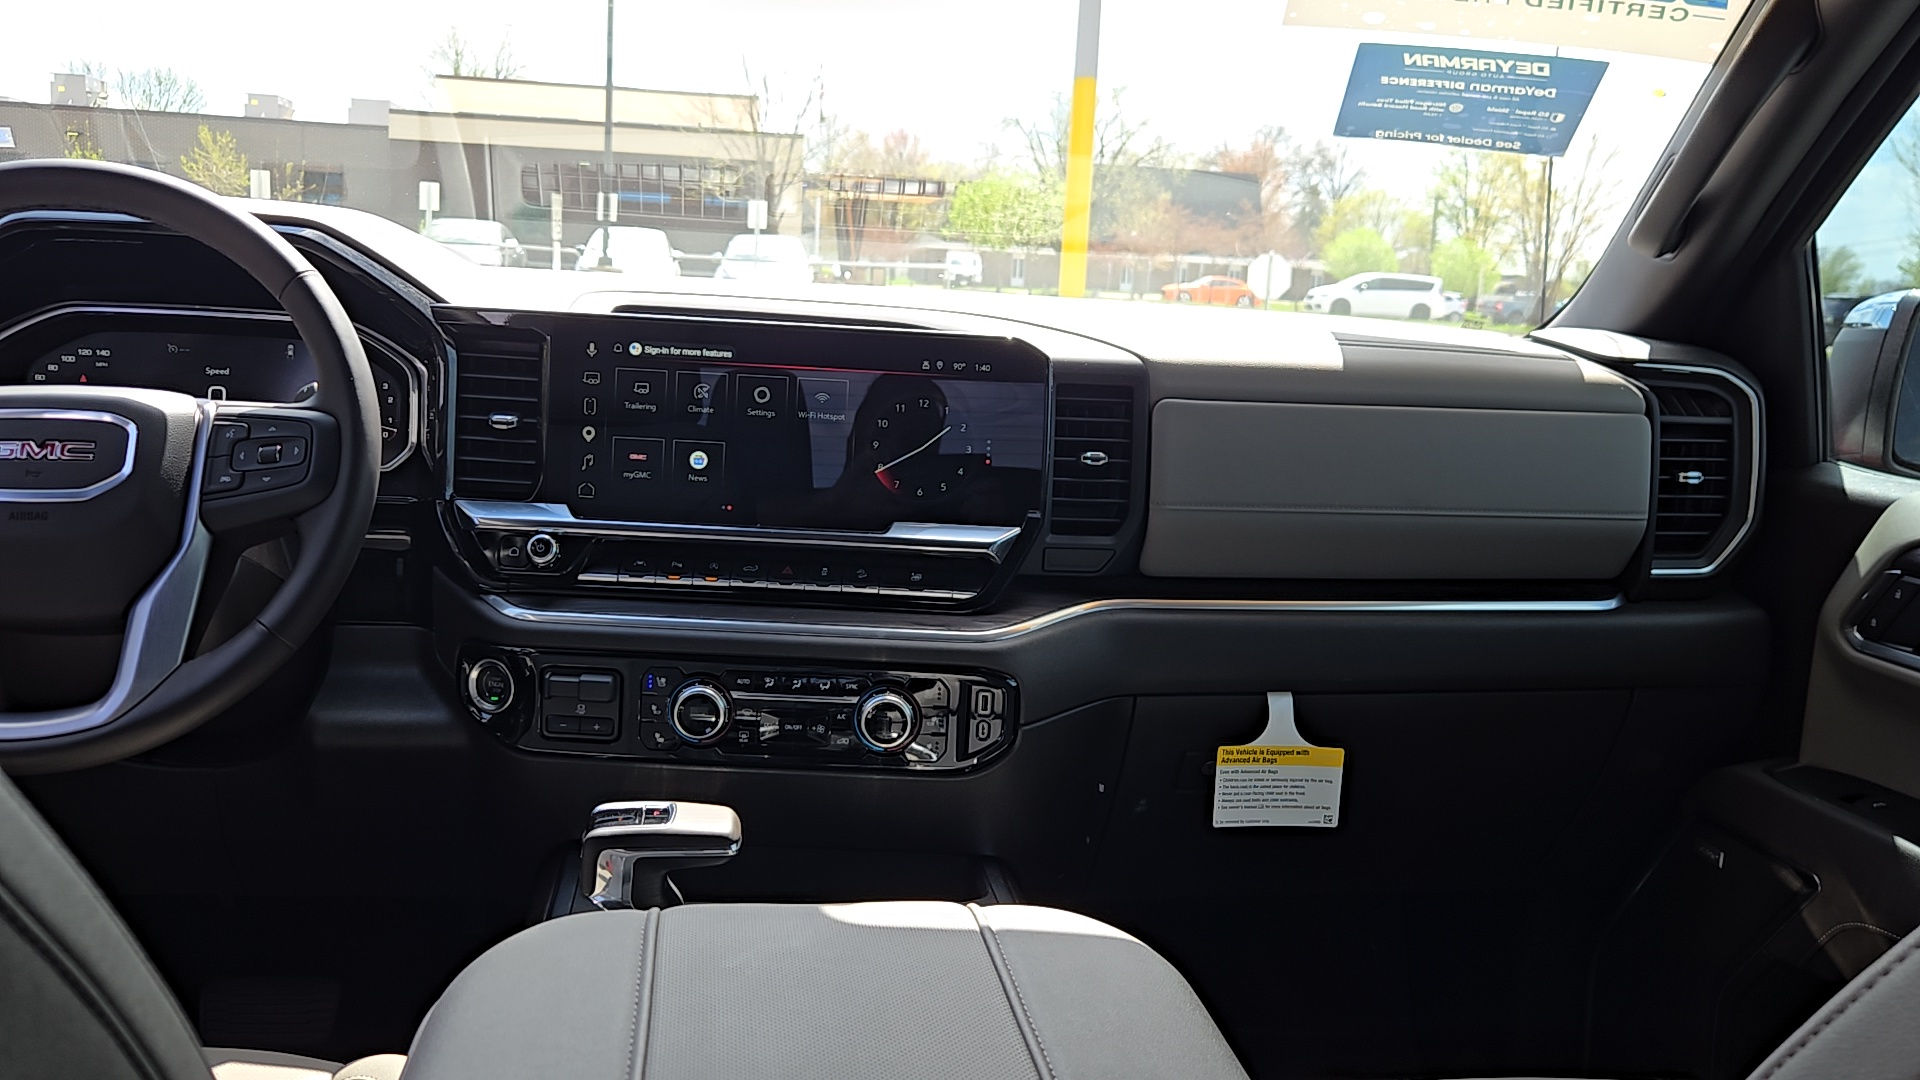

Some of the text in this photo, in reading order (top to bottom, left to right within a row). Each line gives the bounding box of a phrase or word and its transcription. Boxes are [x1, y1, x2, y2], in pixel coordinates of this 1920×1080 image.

[77, 348, 92, 356] 120
[96, 349, 111, 357] 140
[670, 346, 681, 355] for
[702, 348, 733, 358] features
[61, 355, 76, 363] 100
[205, 366, 230, 376] Speed
[975, 364, 991, 372] 1:40
[624, 401, 657, 412] Trailering
[895, 404, 906, 412] 11
[919, 399, 929, 408] 12
[687, 405, 715, 414] Climate
[747, 408, 776, 419] Settings
[944, 406, 950, 415] 1
[818, 411, 846, 422] Hotspot
[877, 419, 889, 428] 10
[960, 424, 967, 432] 2
[872, 441, 879, 449] 9
[966, 445, 972, 454] 3
[0, 440, 95, 460] GMC
[623, 471, 652, 480] myGMC
[957, 467, 964, 476] 4
[688, 474, 708, 482] News
[894, 480, 900, 489] 7
[940, 483, 947, 491] 5
[917, 488, 923, 496] 6
[1222, 748, 1234, 756] This
[1235, 748, 1258, 756] Vehicle
[1259, 748, 1265, 756] is
[1266, 748, 1295, 757] Equipped
[1221, 756, 1251, 764] Advanced
[1262, 757, 1278, 765] Bags
